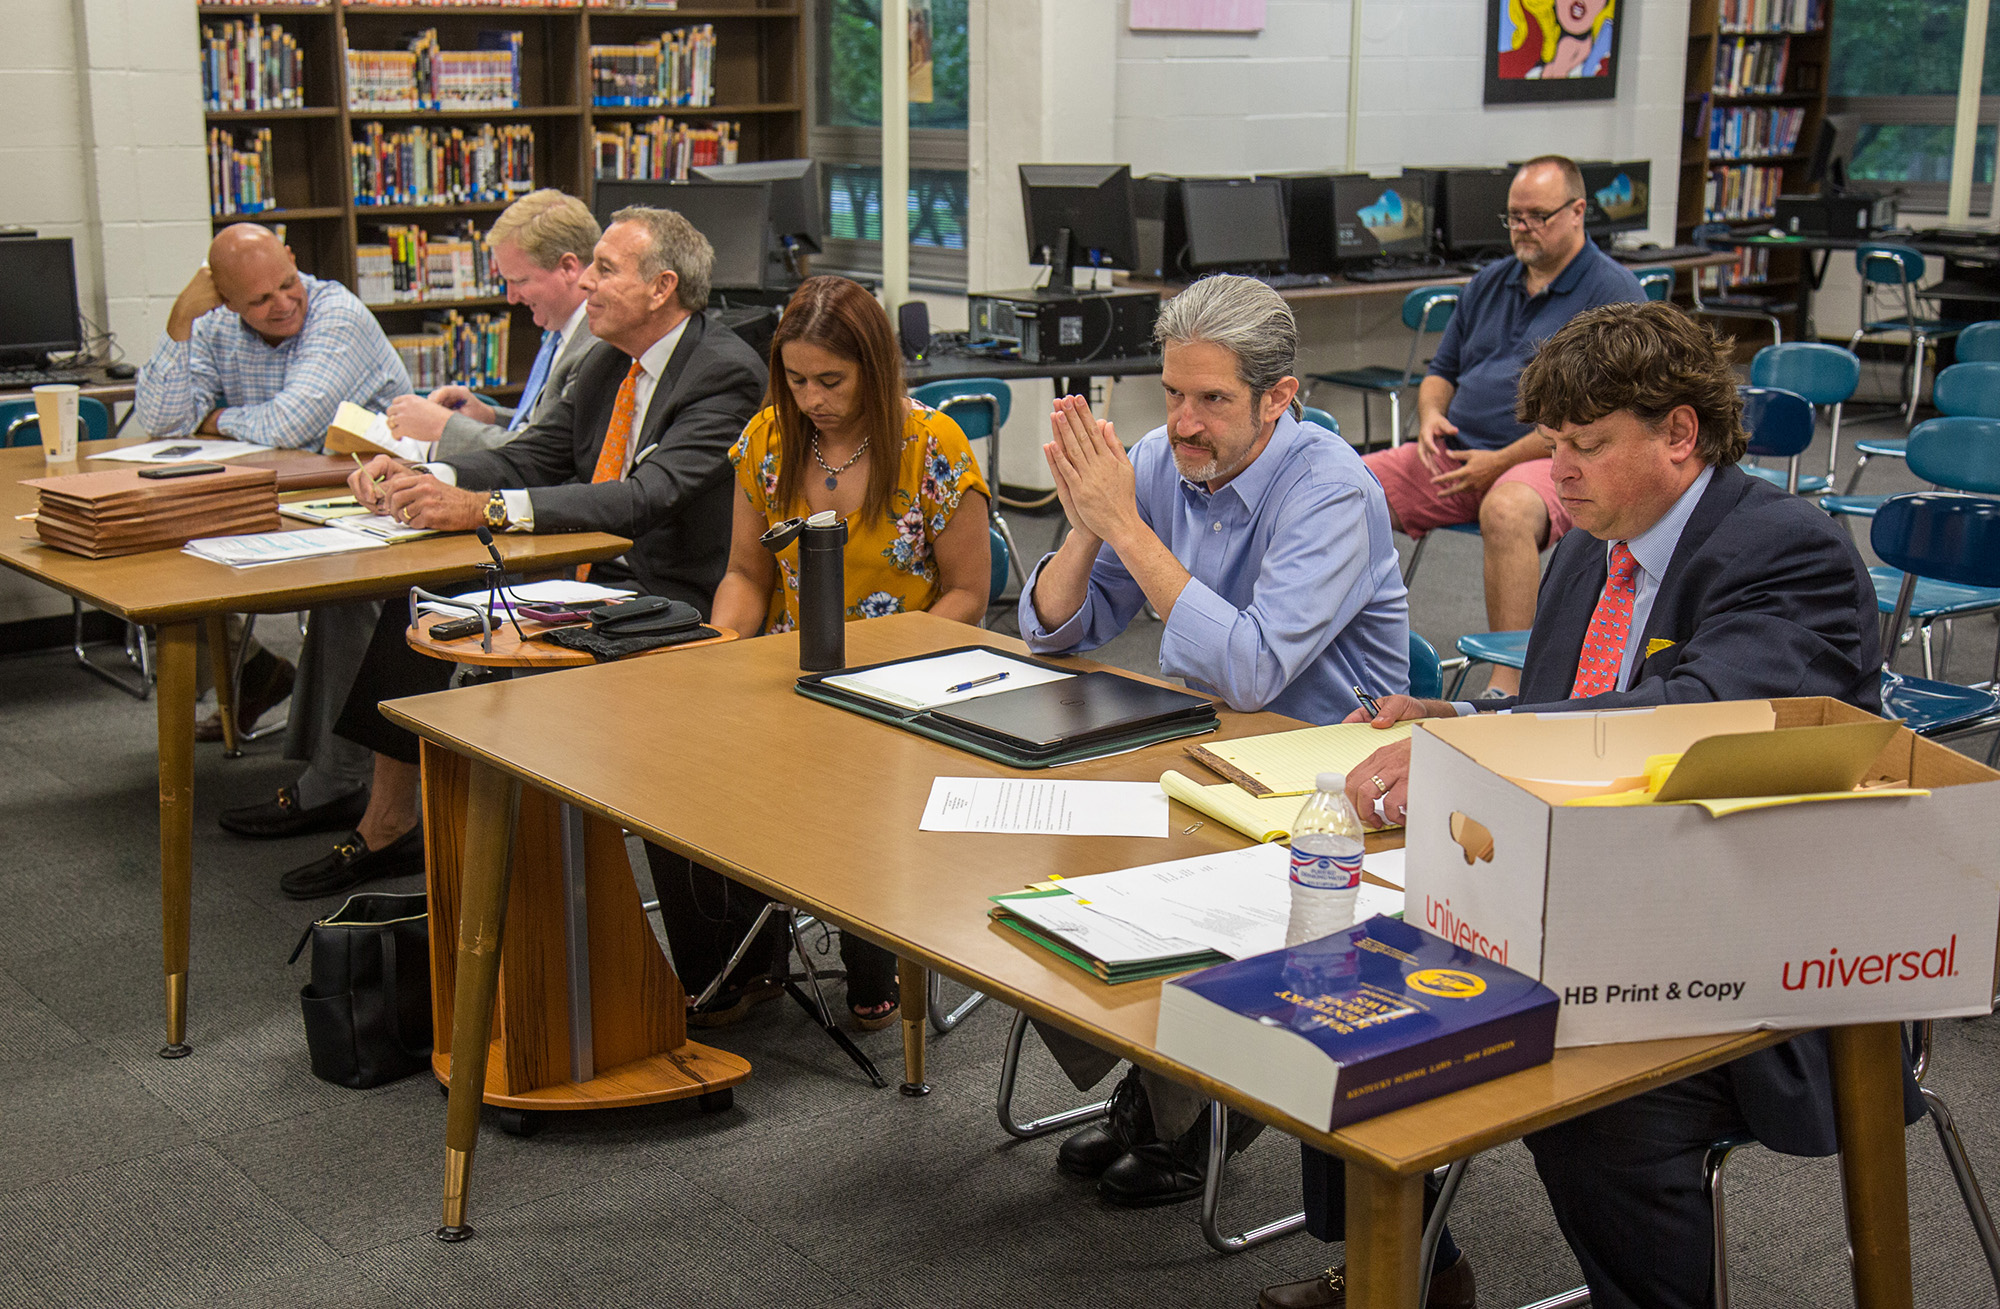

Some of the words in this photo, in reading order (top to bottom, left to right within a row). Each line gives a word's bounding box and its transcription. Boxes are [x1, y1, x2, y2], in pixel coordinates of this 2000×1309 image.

[1564, 986, 1598, 1006] HB
[1606, 984, 1659, 1003] Print
[1666, 982, 1682, 1000] &
[1687, 980, 1746, 1001] Copy
